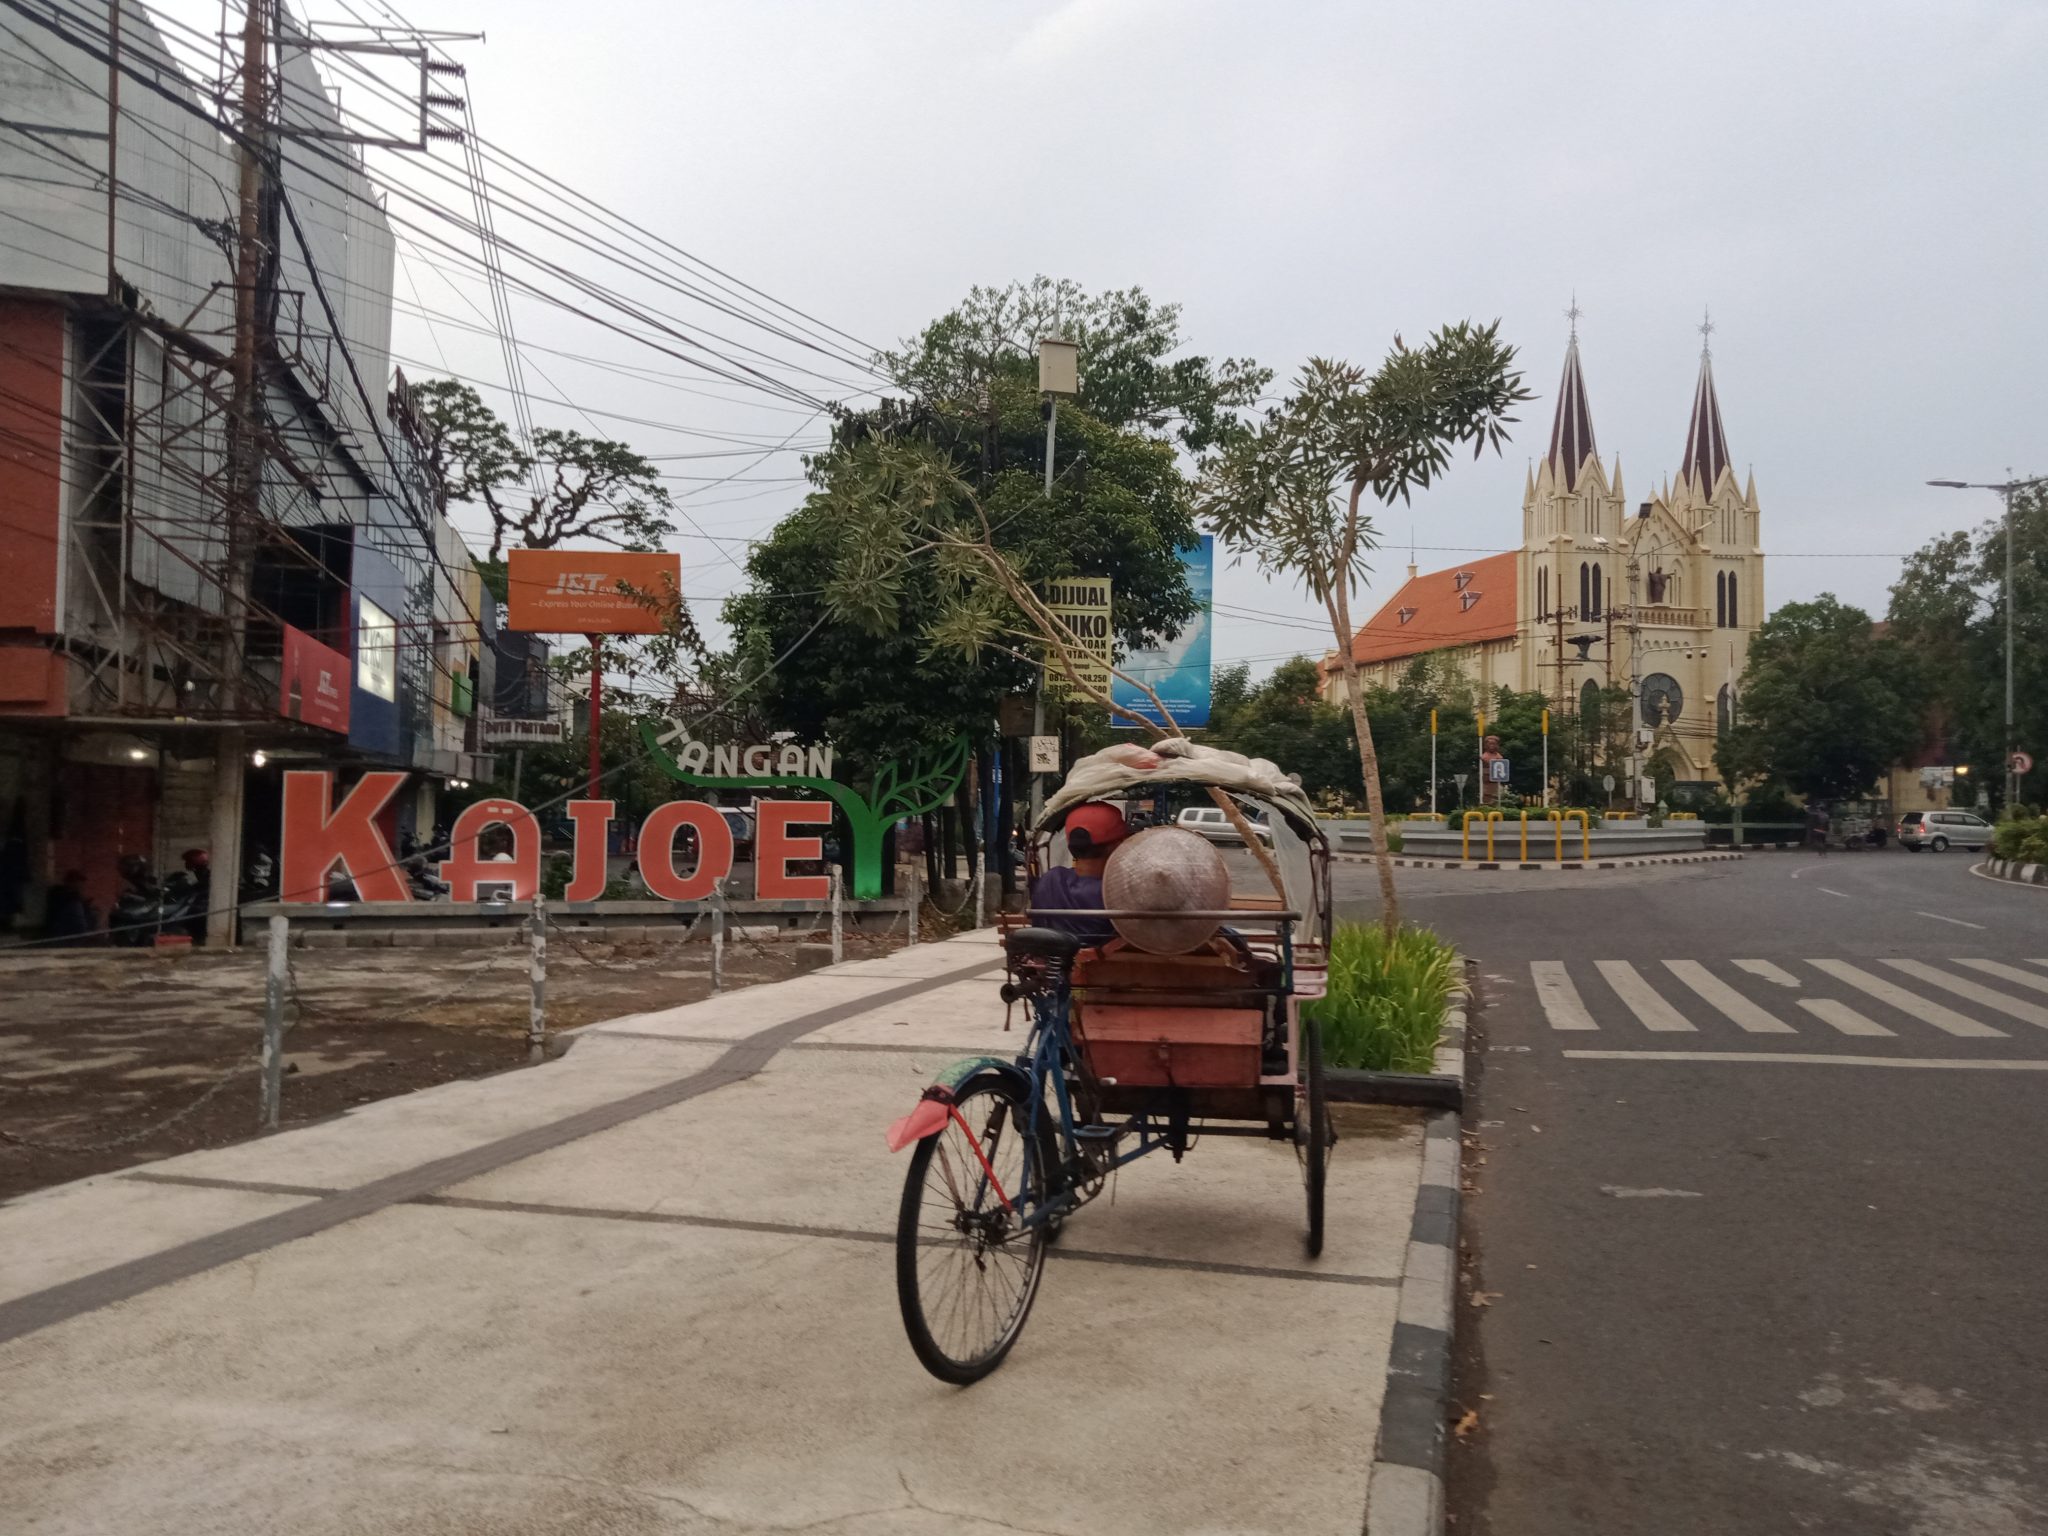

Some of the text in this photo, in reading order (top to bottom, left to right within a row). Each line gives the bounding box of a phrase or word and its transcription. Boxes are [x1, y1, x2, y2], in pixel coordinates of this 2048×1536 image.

[547, 573, 608, 596] J&T
[1049, 585, 1108, 607] DIJUAL
[538, 600, 569, 609] Express
[570, 601, 588, 609] Your
[588, 601, 616, 609] Online
[655, 713, 835, 781] TANGAN
[279, 770, 835, 903] KAJOE
